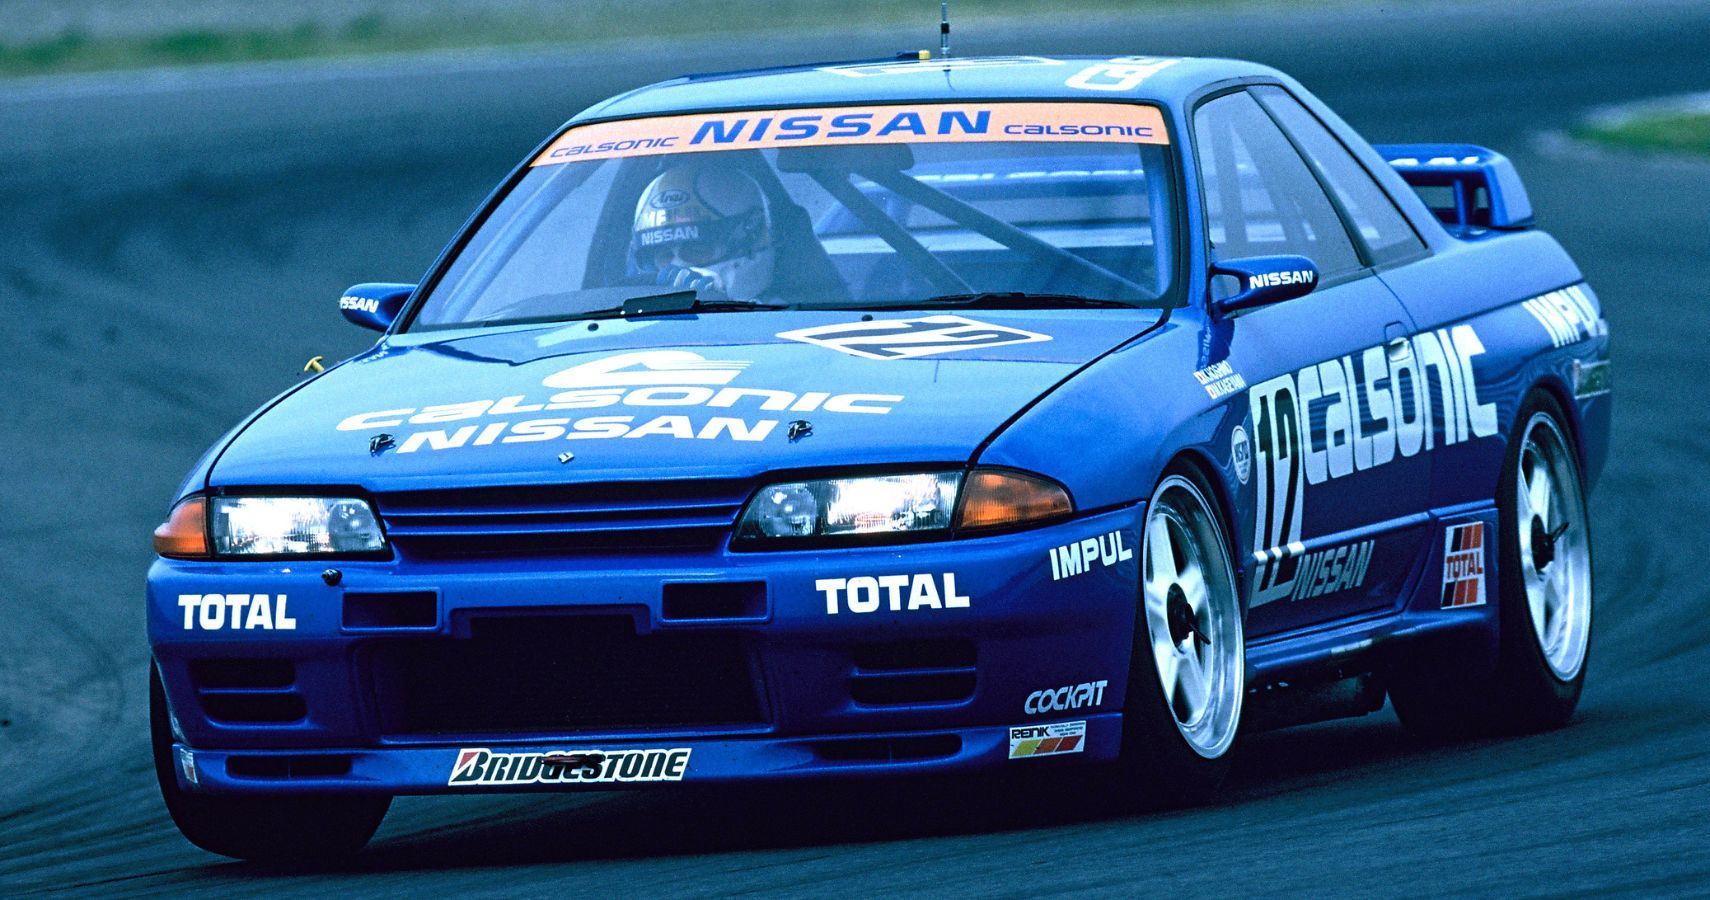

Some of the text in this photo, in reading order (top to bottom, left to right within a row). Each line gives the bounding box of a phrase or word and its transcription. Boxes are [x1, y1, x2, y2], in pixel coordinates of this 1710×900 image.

[689, 110, 991, 145] NISSAN
[641, 226, 699, 246] NISSAN
[1249, 270, 1314, 289] NISSAN
[340, 296, 380, 313] ISSAN
[1522, 285, 1608, 348] IMPUL
[396, 415, 778, 453] NISSAN
[1254, 384, 1300, 594] 12
[1049, 530, 1133, 581] IMPUL
[1291, 539, 1375, 601] NISSAN
[1445, 552, 1483, 579] TOTAL
[815, 572, 970, 614] TOTAL
[178, 593, 296, 630] TOTAL
[1024, 680, 1107, 715] COCKPIT
[451, 750, 687, 783] BRIDGESTONE
